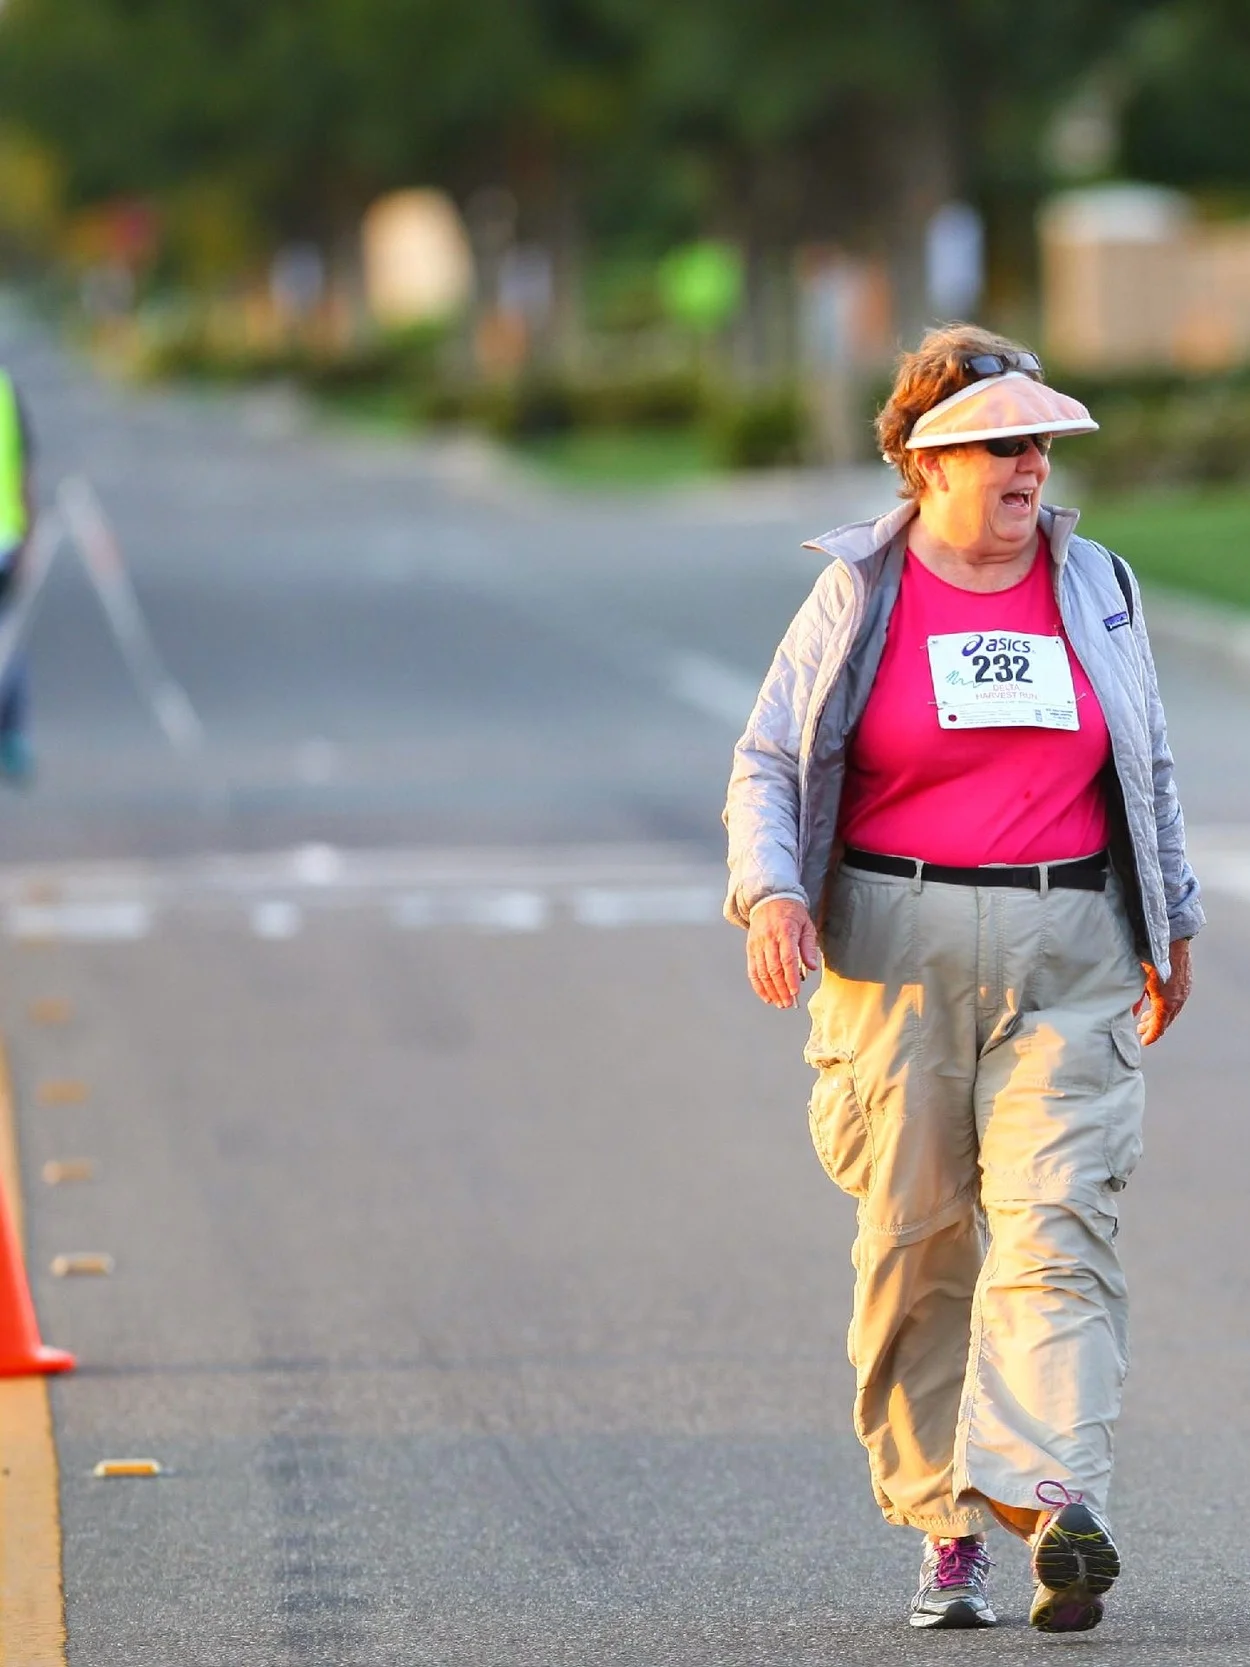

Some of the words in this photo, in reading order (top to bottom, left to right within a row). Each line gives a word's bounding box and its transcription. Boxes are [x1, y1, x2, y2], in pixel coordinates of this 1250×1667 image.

[972, 654, 1033, 683] 232
[992, 683, 1020, 692] DELTA
[975, 691, 1017, 700] HARVEST
[1019, 691, 1038, 700] RUN
